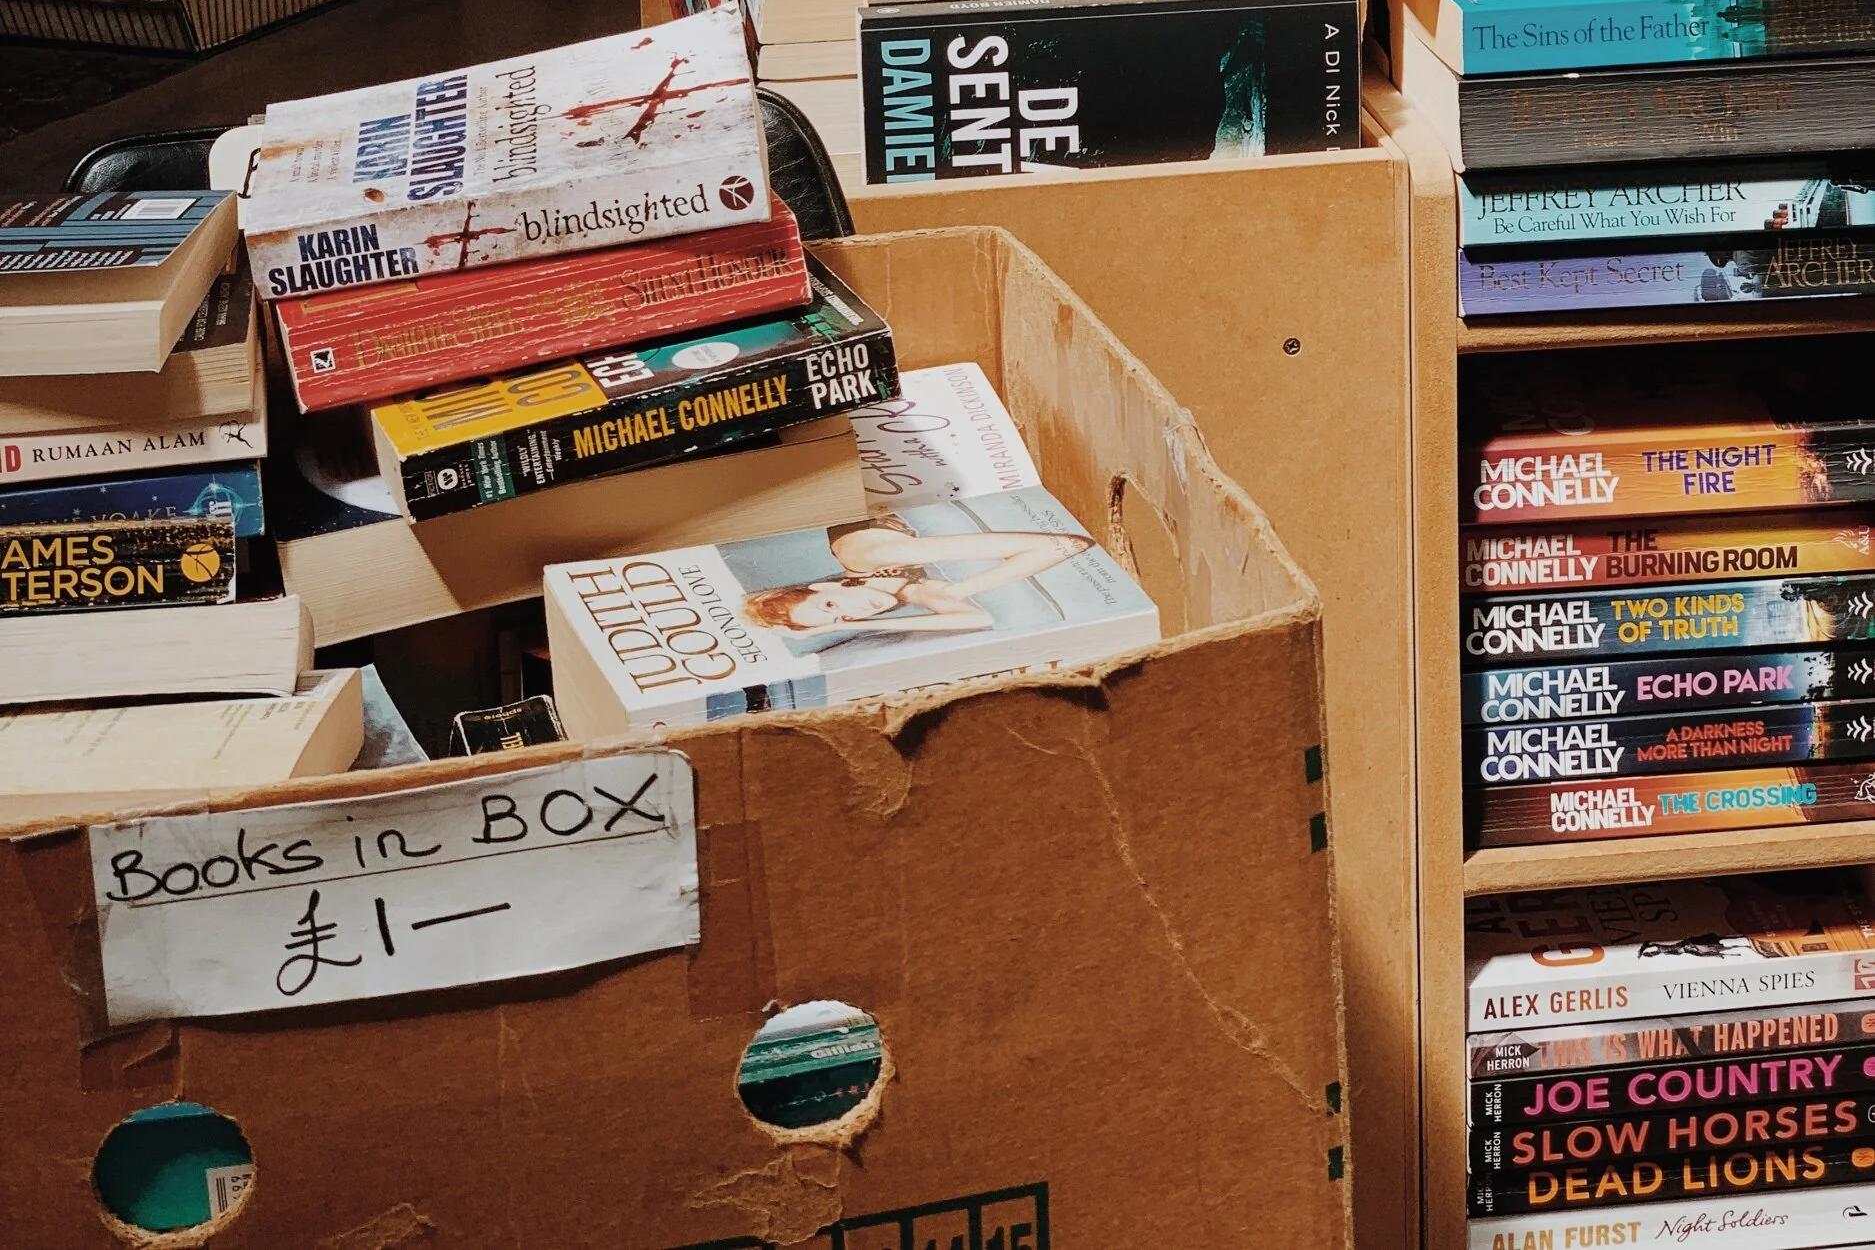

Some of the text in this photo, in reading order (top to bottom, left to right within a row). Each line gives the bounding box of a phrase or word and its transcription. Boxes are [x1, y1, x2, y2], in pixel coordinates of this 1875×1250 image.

[1473, 13, 1710, 51] The Sins of the Father
[1325, 23, 1340, 137] A DI Nick
[407, 74, 468, 201] SLAUGHTER
[492, 65, 552, 183] blindsighted
[352, 113, 411, 183] KARIN
[521, 185, 710, 244] blindsighted
[1479, 177, 1746, 220] JEFFREY ARCHER
[1494, 207, 1737, 234] Be Careful What You Wish For
[298, 224, 379, 262] KARIN
[268, 247, 418, 295] SLAUGHTER
[1478, 257, 1685, 293] Best Kept Secret
[806, 343, 869, 382] ECHO
[812, 370, 877, 410] PARK
[573, 374, 789, 459] MICHAEL CONNELLY
[946, 367, 1023, 490] MIRANDA DICKINSON
[33, 431, 206, 463] RUMAAN ALAM
[1642, 444, 1776, 472] THE NIGHT
[1480, 452, 1611, 482] MICHAEL
[1684, 472, 1736, 495] FIRE
[1473, 477, 1619, 510] CONNELLY
[1467, 534, 1581, 560] MICHAEL
[1608, 529, 1658, 553] THE
[1465, 556, 1598, 586] CONNELLY
[1606, 546, 1798, 579] BURNING ROOM
[622, 561, 737, 681] GOULD
[678, 564, 768, 664] SECOND LOVE
[1472, 600, 1598, 629] MICHAEL
[1611, 594, 1745, 620] TWO KINDS
[567, 566, 702, 694] JUDITH
[1466, 623, 1605, 655] CONNELLY
[1618, 617, 1737, 642] OF TRUTH
[1488, 667, 1617, 698] MICHAEL
[1637, 665, 1793, 701] ECHO PARK
[1480, 690, 1625, 722] CONNELLY
[1487, 724, 1616, 753] MICHAEL
[1637, 735, 1793, 761] MORE THAN NIGHT
[1667, 721, 1764, 742] A DARKNESS
[1480, 747, 1624, 781] CONNELLY
[1550, 787, 1642, 811] MICHAEL
[1657, 783, 1816, 814] THE CROSSING
[105, 773, 666, 901] Books in BOX
[1551, 806, 1655, 833] CONNELLY
[1484, 970, 1815, 1020] ALEX GERLIS VIENNA SPIES
[1495, 1044, 1522, 1058] MICK
[1538, 1013, 1839, 1069] THIS IS WHAT HAPPENED
[1486, 1056, 1530, 1071] HERRON
[1494, 1083, 1502, 1122] HERRON
[1524, 1055, 1843, 1116] JOE COUNTRY
[1485, 1091, 1493, 1116] MICK
[1493, 1131, 1501, 1170] HERRON
[1512, 1100, 1858, 1166] SLOW HORSES
[1485, 1139, 1493, 1163] MICK
[1528, 1145, 1826, 1206] DEAD LIONS
[1492, 1211, 1789, 1250] ALAN FURST Night Soldiers
